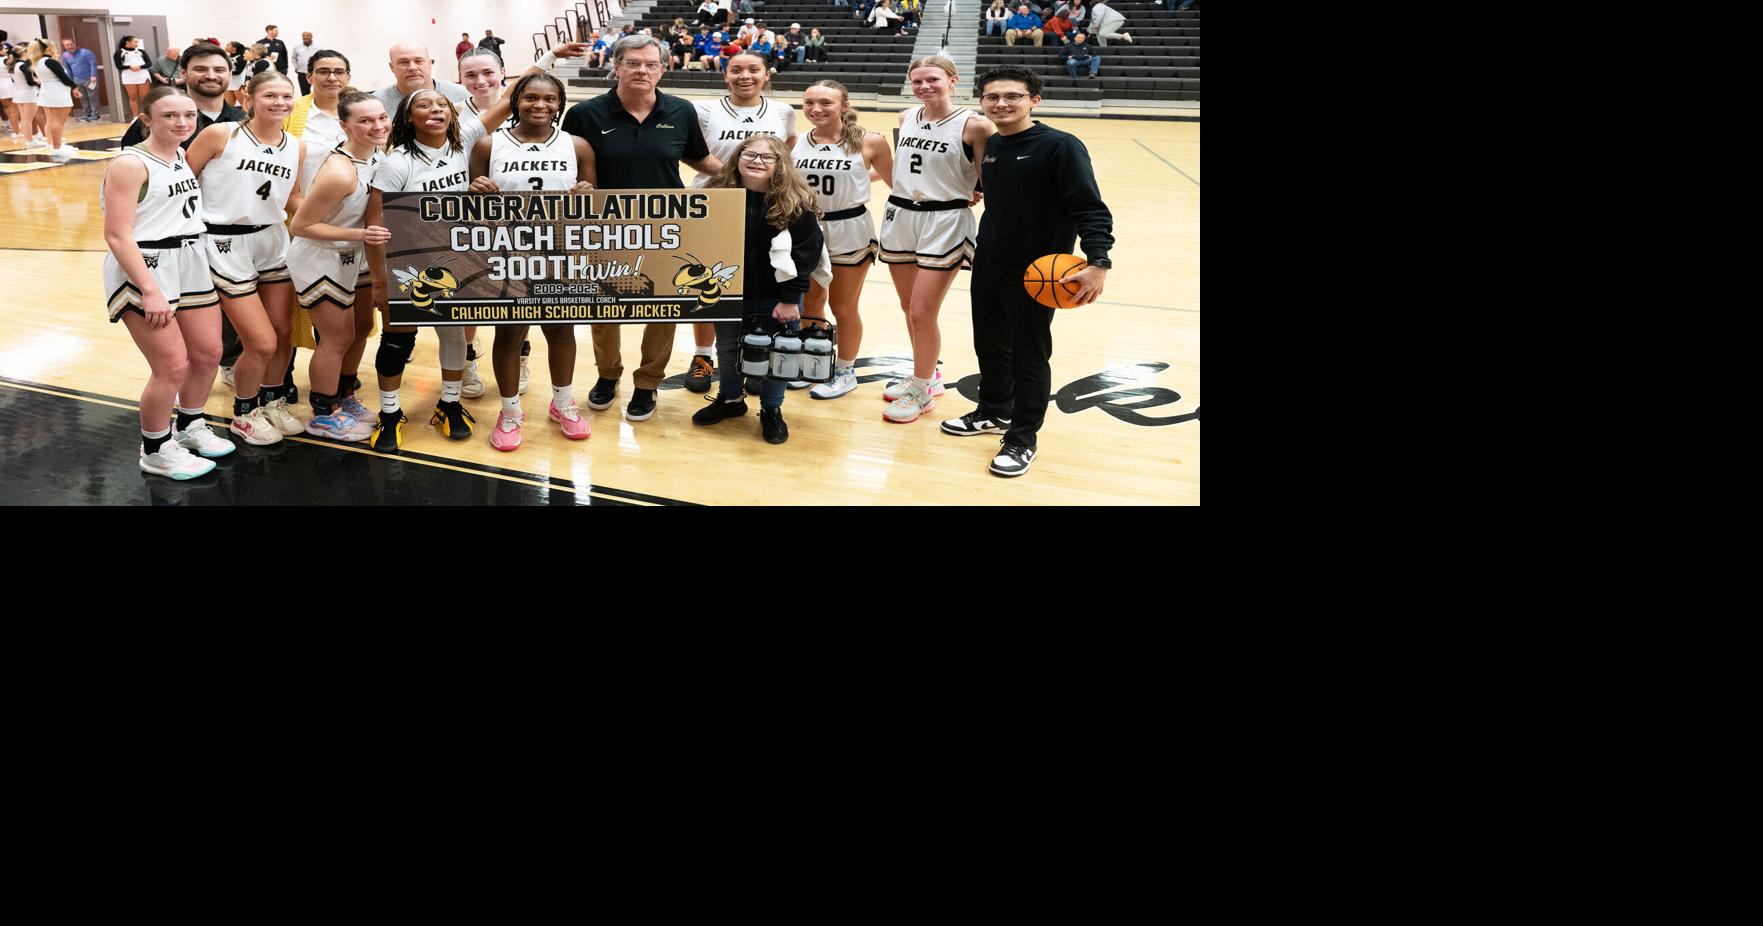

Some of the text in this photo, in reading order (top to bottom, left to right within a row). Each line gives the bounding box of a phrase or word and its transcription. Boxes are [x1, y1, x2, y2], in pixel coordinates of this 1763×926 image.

[719, 130, 776, 140] JACK
[899, 136, 949, 153] JACKETS
[236, 158, 292, 180] JACKETS
[502, 160, 568, 173] JACKETS
[795, 158, 852, 171] JACKETS
[910, 153, 922, 174] 2
[255, 180, 273, 201] 4
[528, 176, 544, 191] 3
[806, 173, 835, 196] 20
[419, 193, 710, 223] CONGRATULATIONS
[450, 223, 682, 252] COACH ECHOLS
[487, 254, 643, 282] 300TH Win!
[533, 283, 599, 295] 2009-2025
[516, 296, 617, 305] VARSITY GIRLS BASKETBALL COACH
[451, 303, 681, 320] CALHOUN HIGH SCHOOL LADY JACKETS
